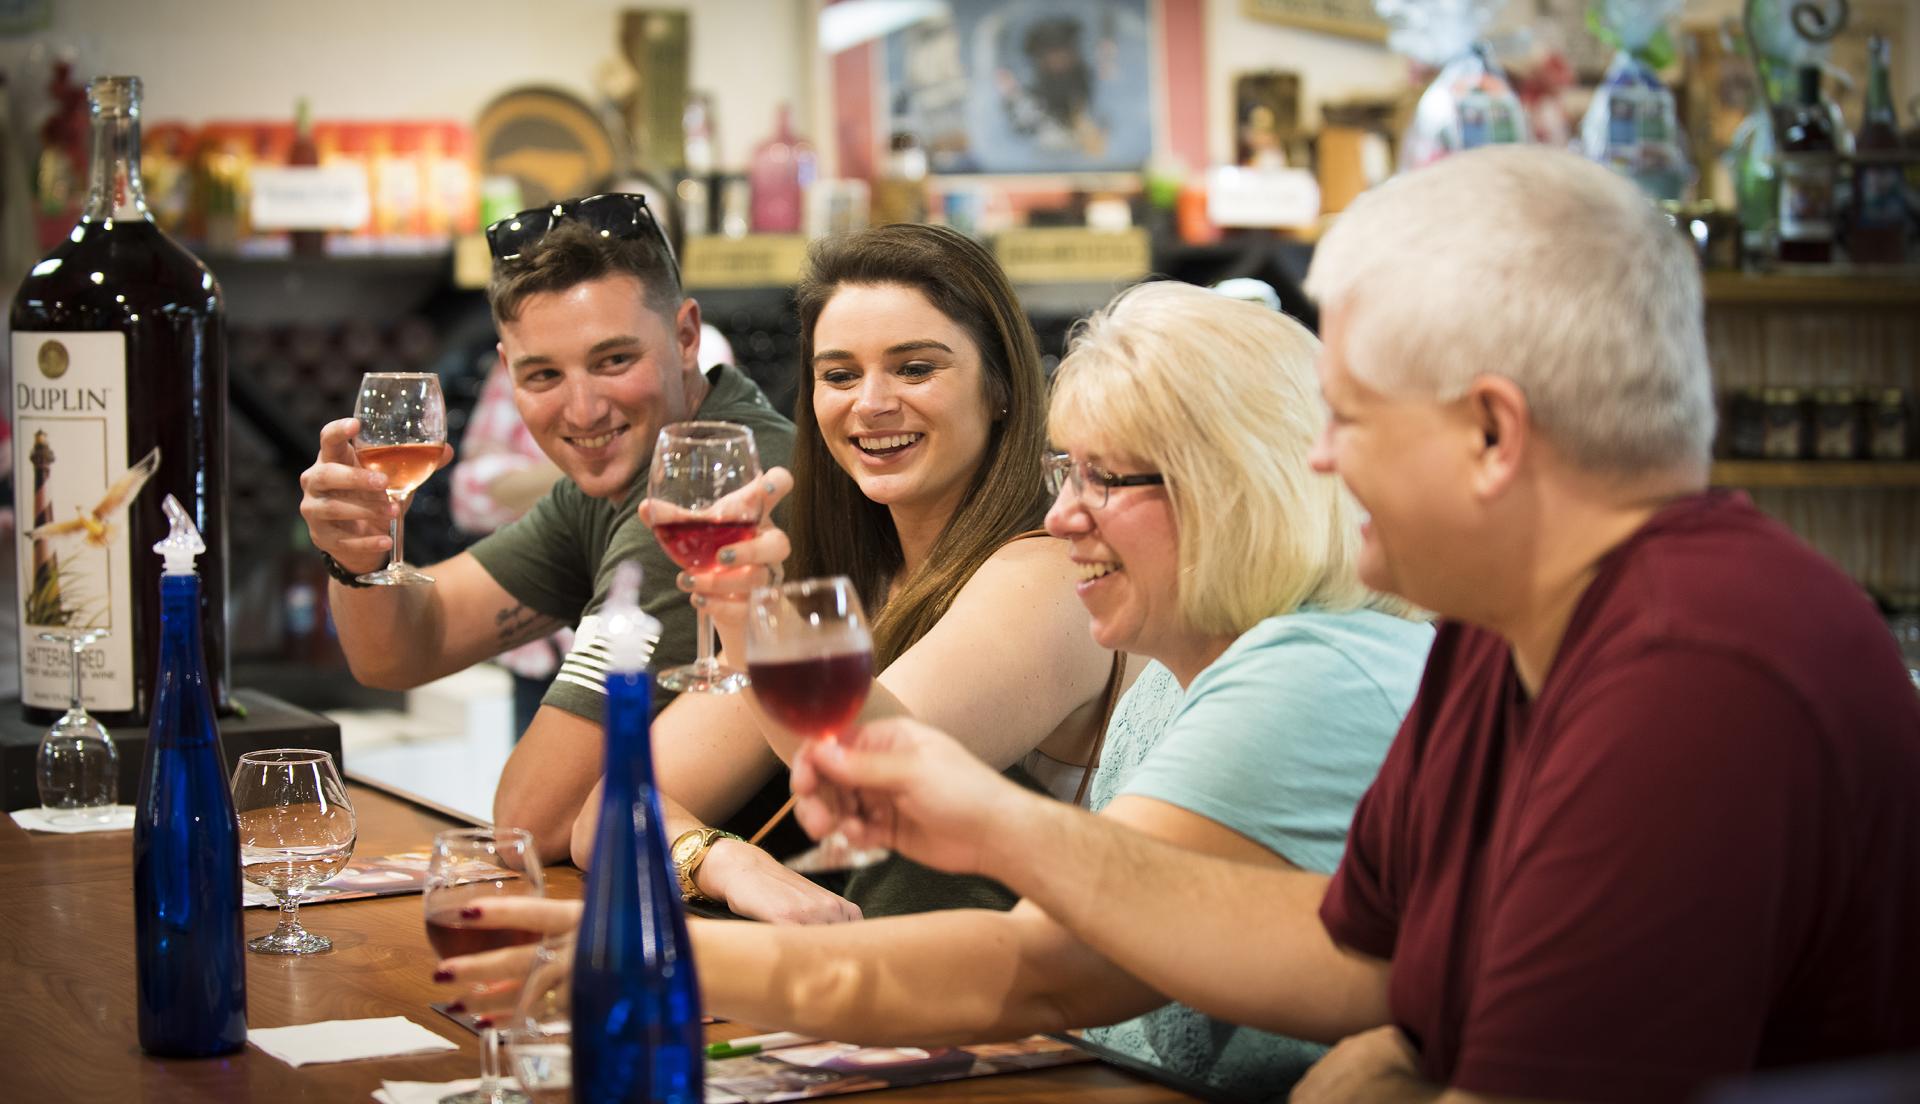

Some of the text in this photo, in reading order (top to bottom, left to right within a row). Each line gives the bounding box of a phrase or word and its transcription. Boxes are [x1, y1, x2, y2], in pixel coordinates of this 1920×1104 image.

[17, 383, 107, 411] DUPLIN
[79, 649, 105, 669] RED
[91, 671, 115, 680] WINE
